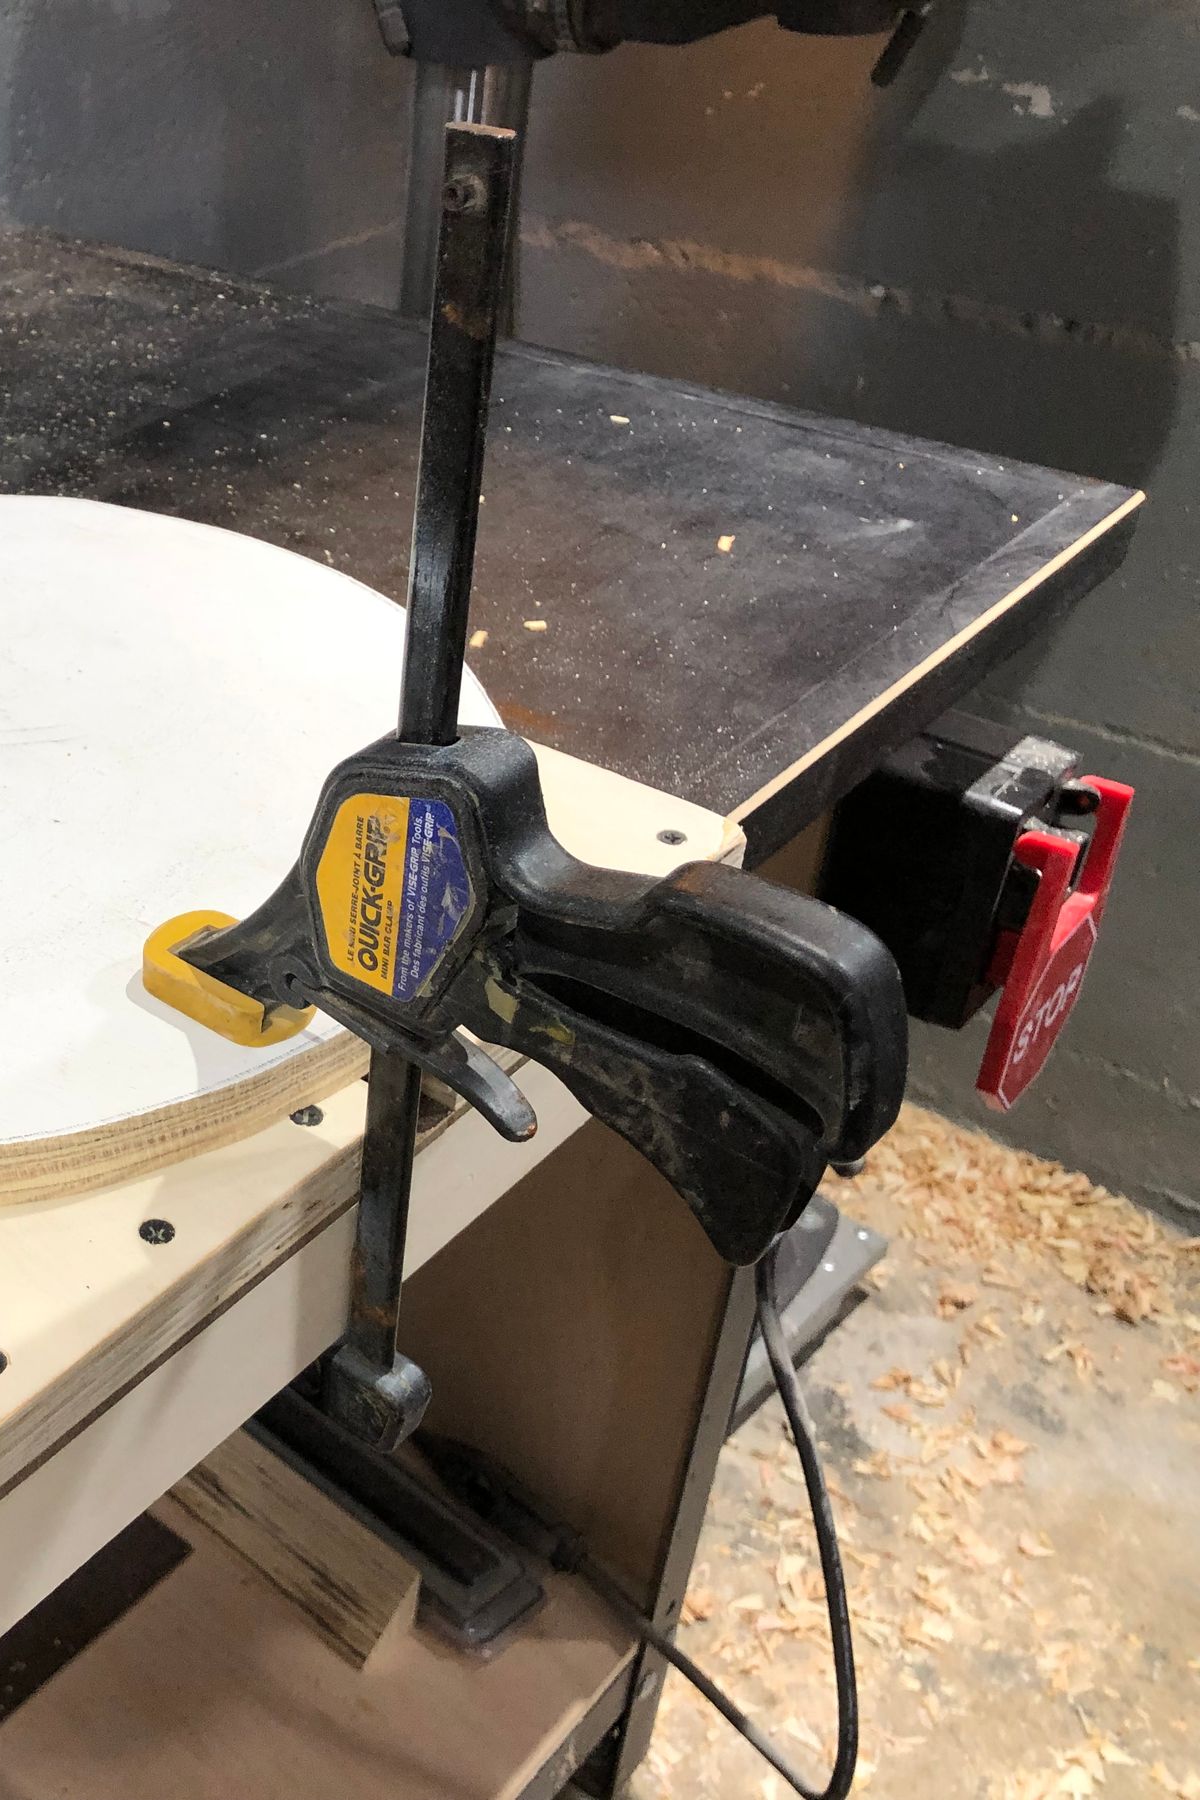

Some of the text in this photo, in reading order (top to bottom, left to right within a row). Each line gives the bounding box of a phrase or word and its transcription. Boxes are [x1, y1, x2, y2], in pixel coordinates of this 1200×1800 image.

[355, 815, 364, 850] BARRE
[411, 816, 423, 844] Tools.
[350, 861, 361, 925] SERRE-JOINT
[357, 815, 388, 972] QUICK-GRIP
[420, 866, 430, 895] outils
[406, 898, 415, 911] of
[419, 894, 428, 914] des
[404, 912, 414, 949] makers
[413, 915, 425, 958] fabricant
[347, 949, 355, 961] LE
[383, 936, 392, 956] BAR
[402, 949, 410, 965] the
[381, 957, 389, 979] MINI
[398, 966, 408, 991] From
[410, 960, 420, 978] Des
[1012, 962, 1084, 1065] STOP
